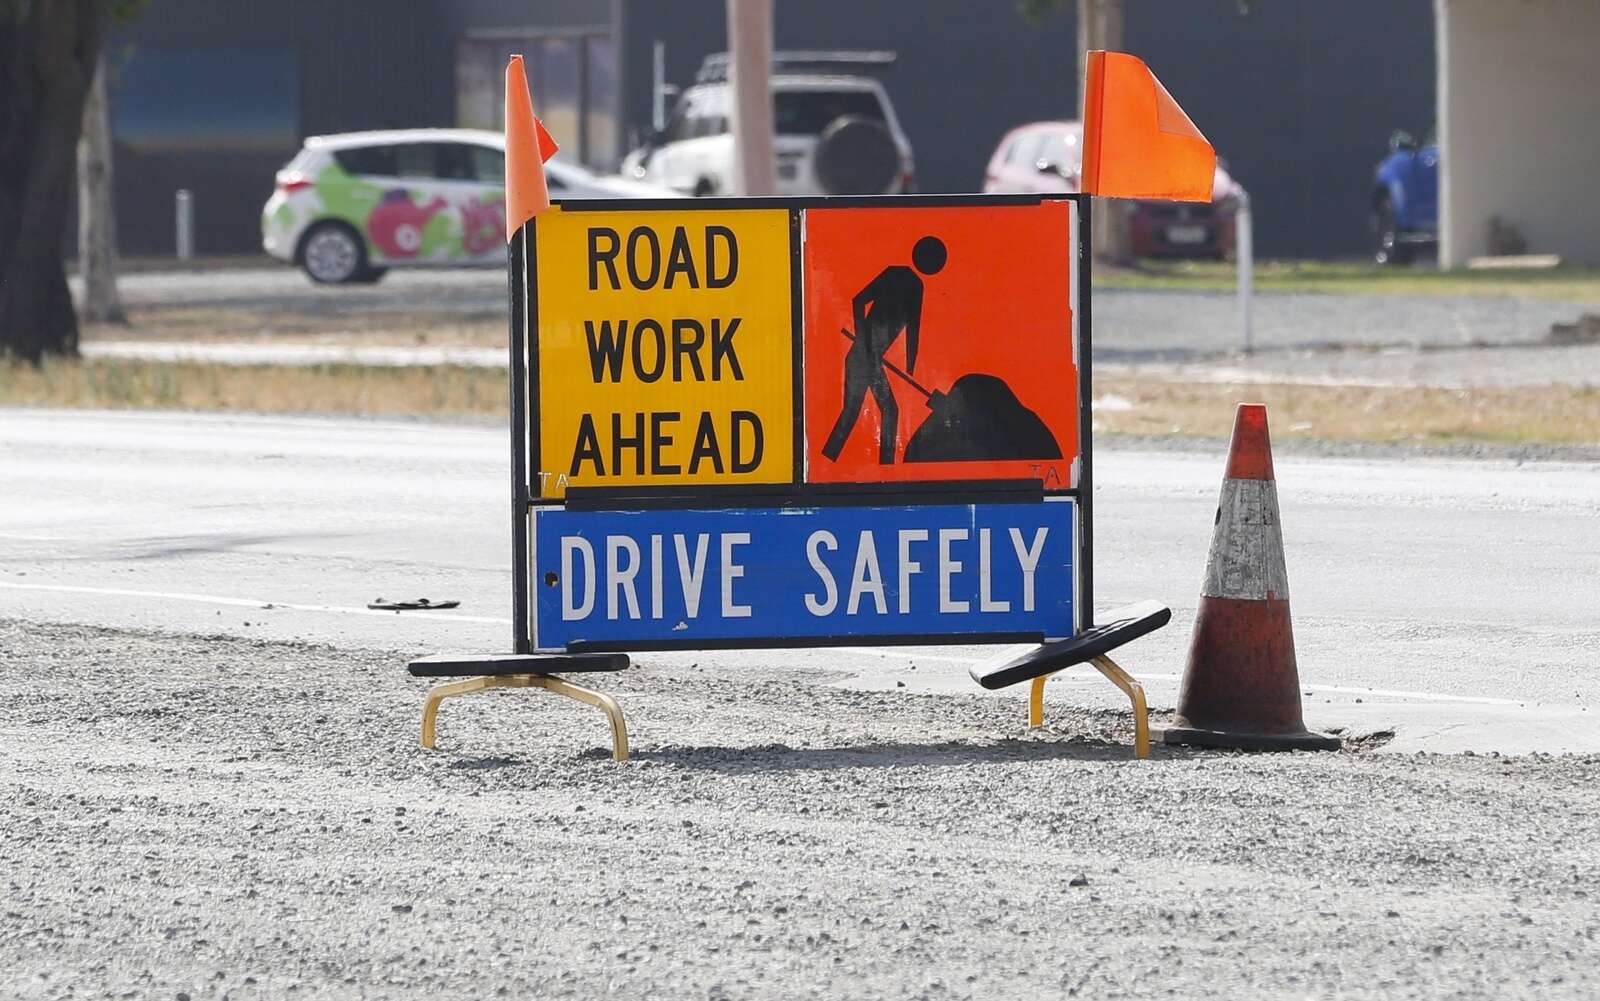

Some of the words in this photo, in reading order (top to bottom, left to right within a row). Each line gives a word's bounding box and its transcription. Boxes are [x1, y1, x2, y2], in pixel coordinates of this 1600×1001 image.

[587, 225, 739, 291] ROAD
[584, 318, 745, 384] WORK
[568, 410, 764, 477] AHEAD
[560, 532, 752, 621] DRIVE
[804, 527, 1050, 617] SAFELY
